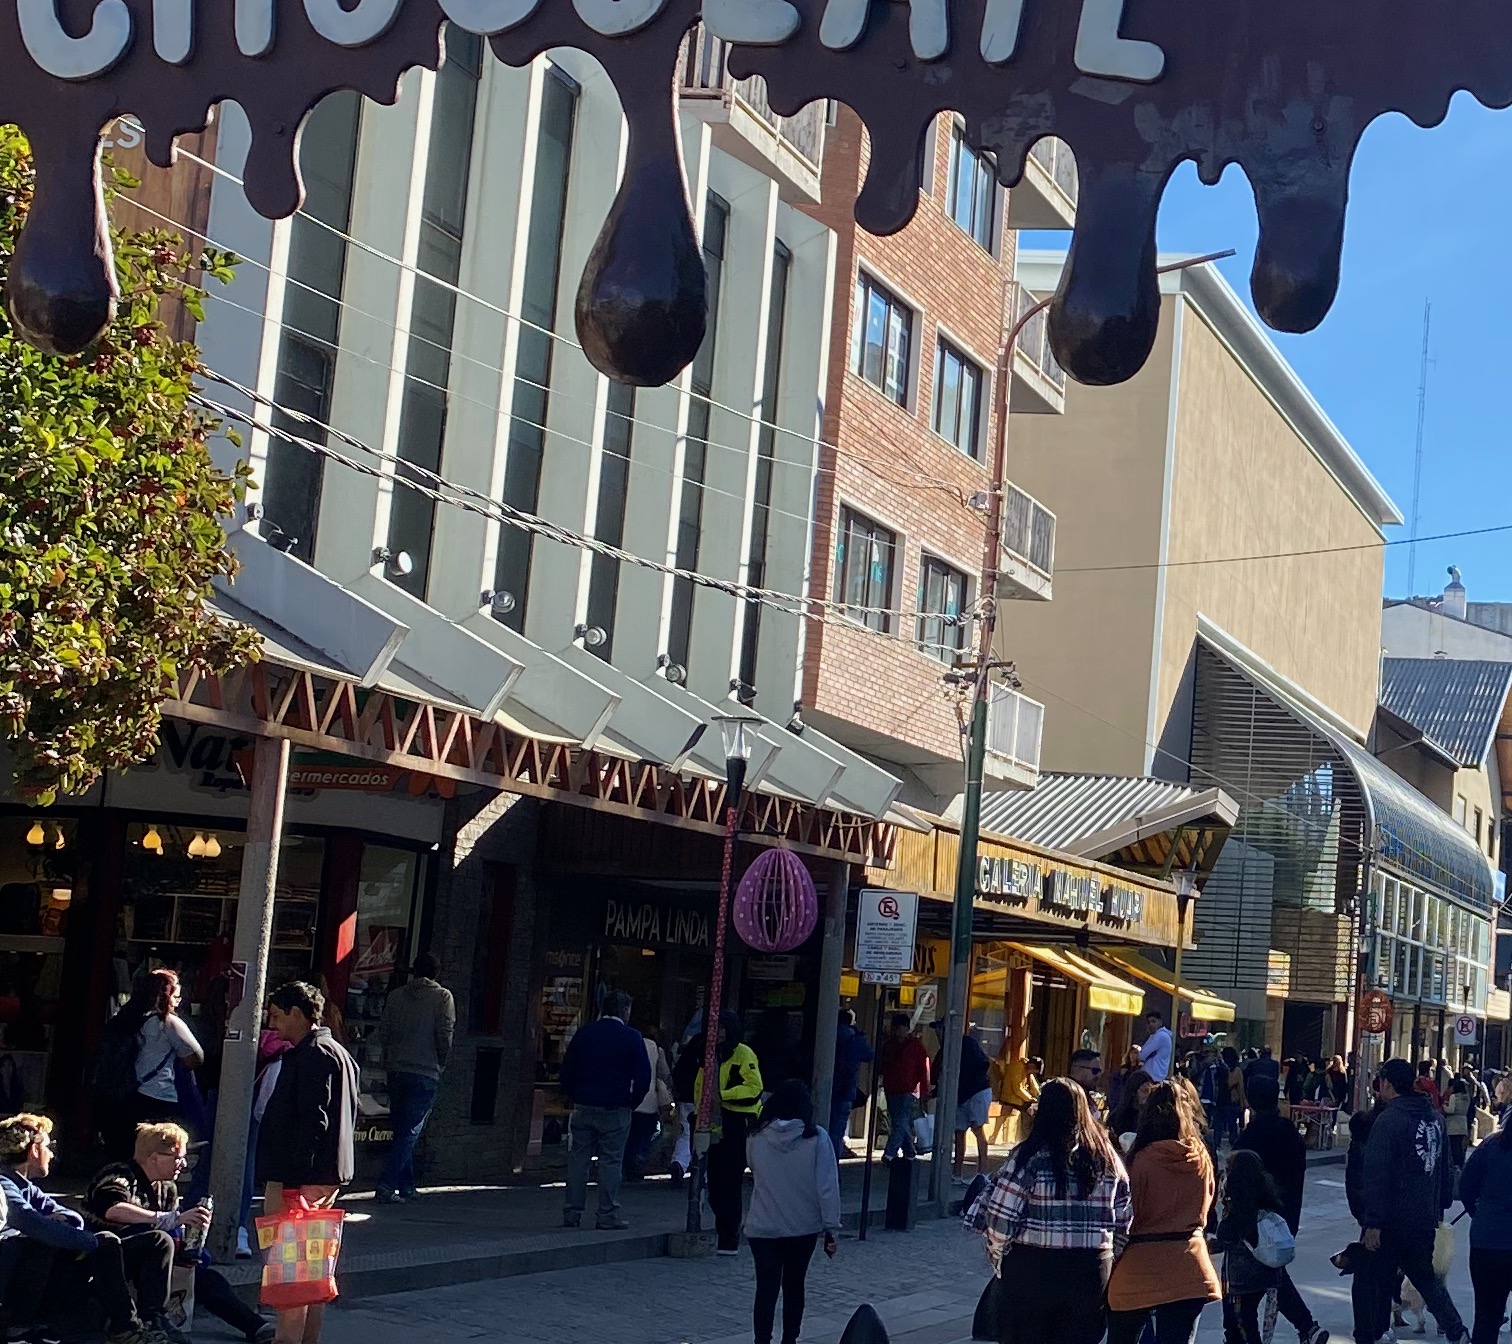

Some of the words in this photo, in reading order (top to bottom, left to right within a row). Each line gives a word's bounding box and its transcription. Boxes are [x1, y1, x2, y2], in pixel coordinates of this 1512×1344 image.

[289, 770, 389, 787] ermercados
[979, 855, 1044, 900] GALERIA
[1053, 869, 1104, 914] NAHUEL
[604, 899, 661, 942] PAMPA
[665, 907, 709, 948] LINDA
